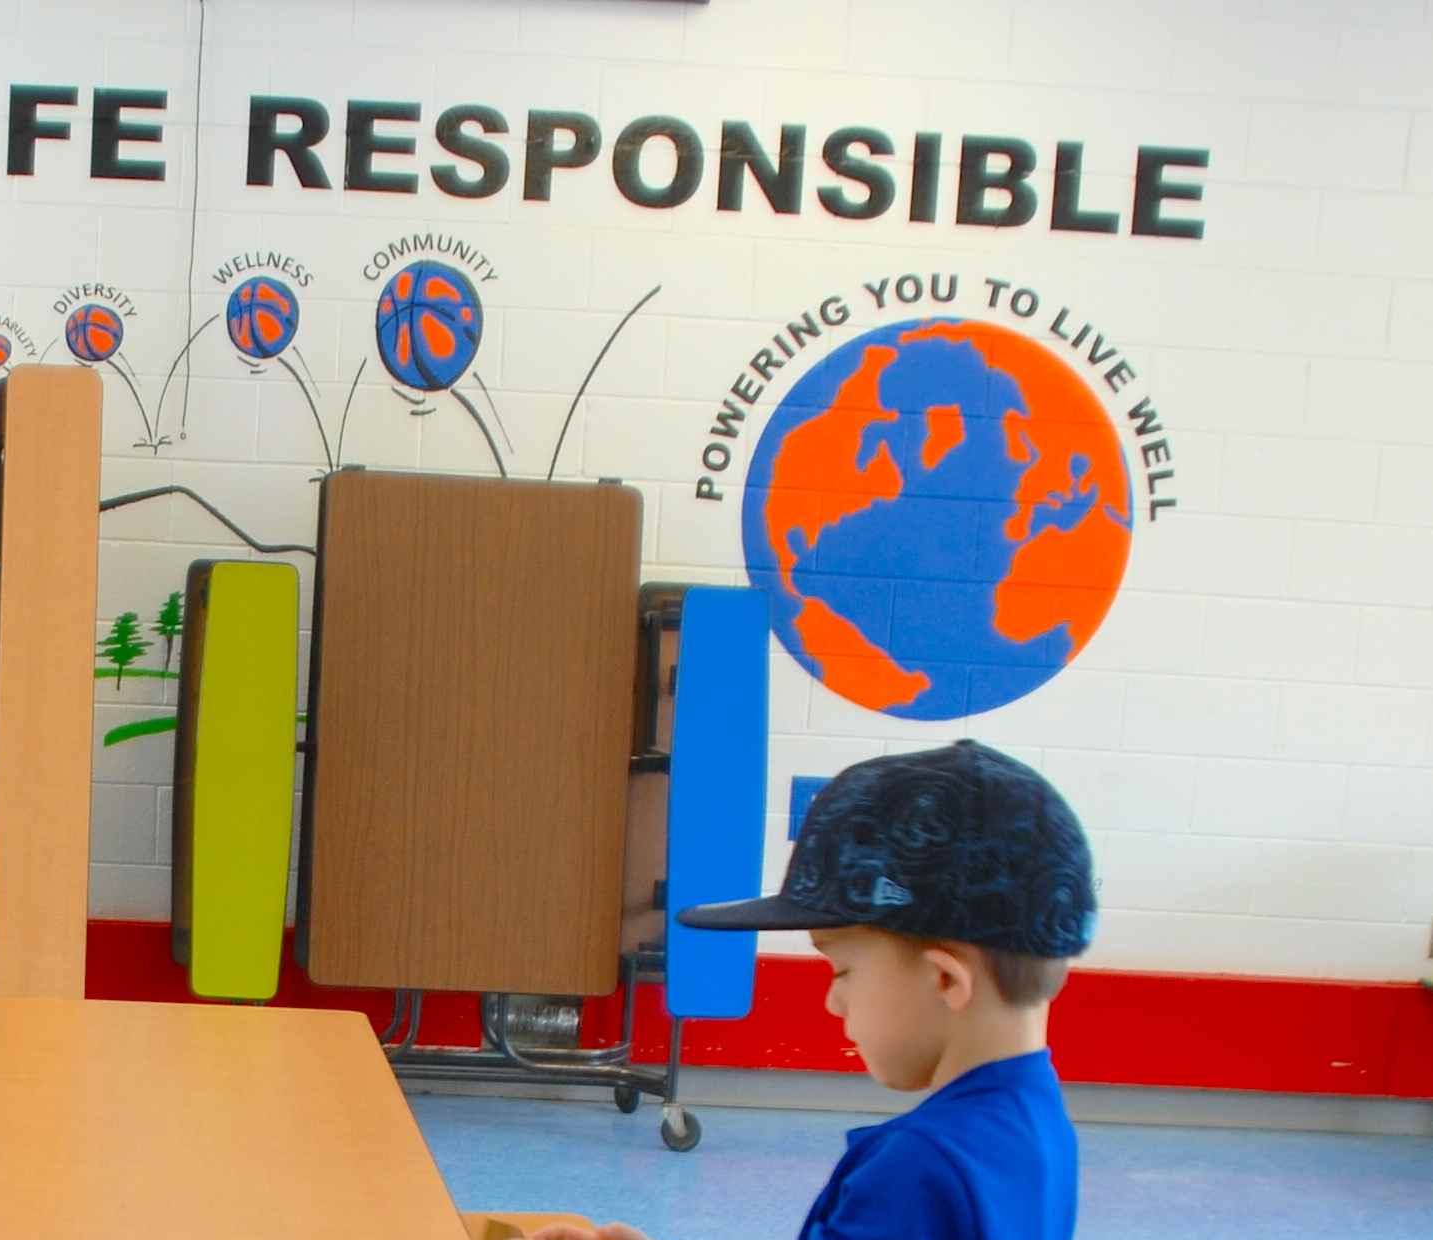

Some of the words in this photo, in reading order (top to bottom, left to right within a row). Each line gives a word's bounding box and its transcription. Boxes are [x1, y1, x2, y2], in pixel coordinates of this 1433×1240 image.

[244, 94, 1210, 241] RESPONSIBLE
[212, 251, 315, 288] WELLNESS
[363, 233, 498, 285] COMMUNITY
[52, 282, 138, 320] DIVERSITY
[695, 294, 852, 502] POWERING
[863, 273, 958, 311] YOU
[984, 277, 1040, 318] TO
[1048, 306, 1137, 394] LIVE
[1127, 396, 1178, 522] WELL
